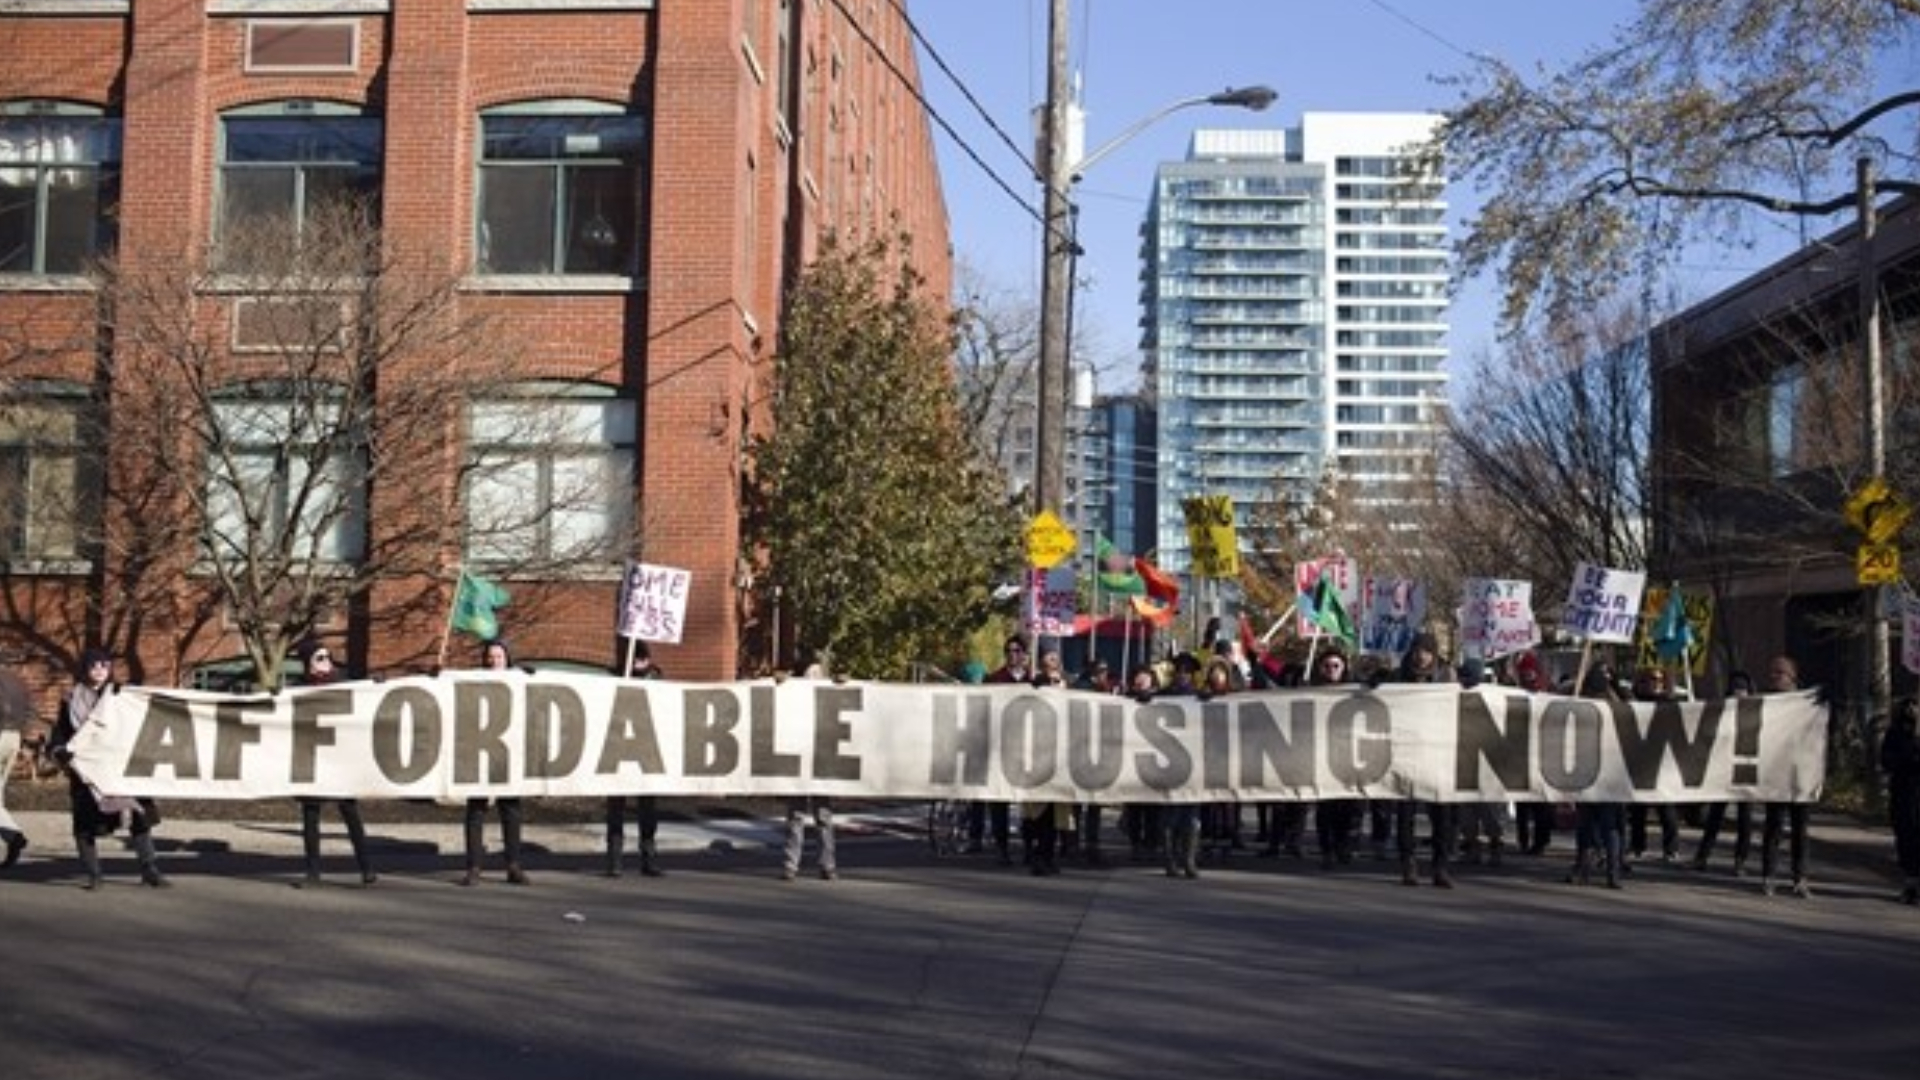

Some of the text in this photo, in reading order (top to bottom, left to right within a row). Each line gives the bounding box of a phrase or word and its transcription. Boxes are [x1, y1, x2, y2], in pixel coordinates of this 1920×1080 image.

[1865, 548, 1893, 569] 20
[123, 680, 1764, 792] AFFORDABLE HOUSING NOW!
